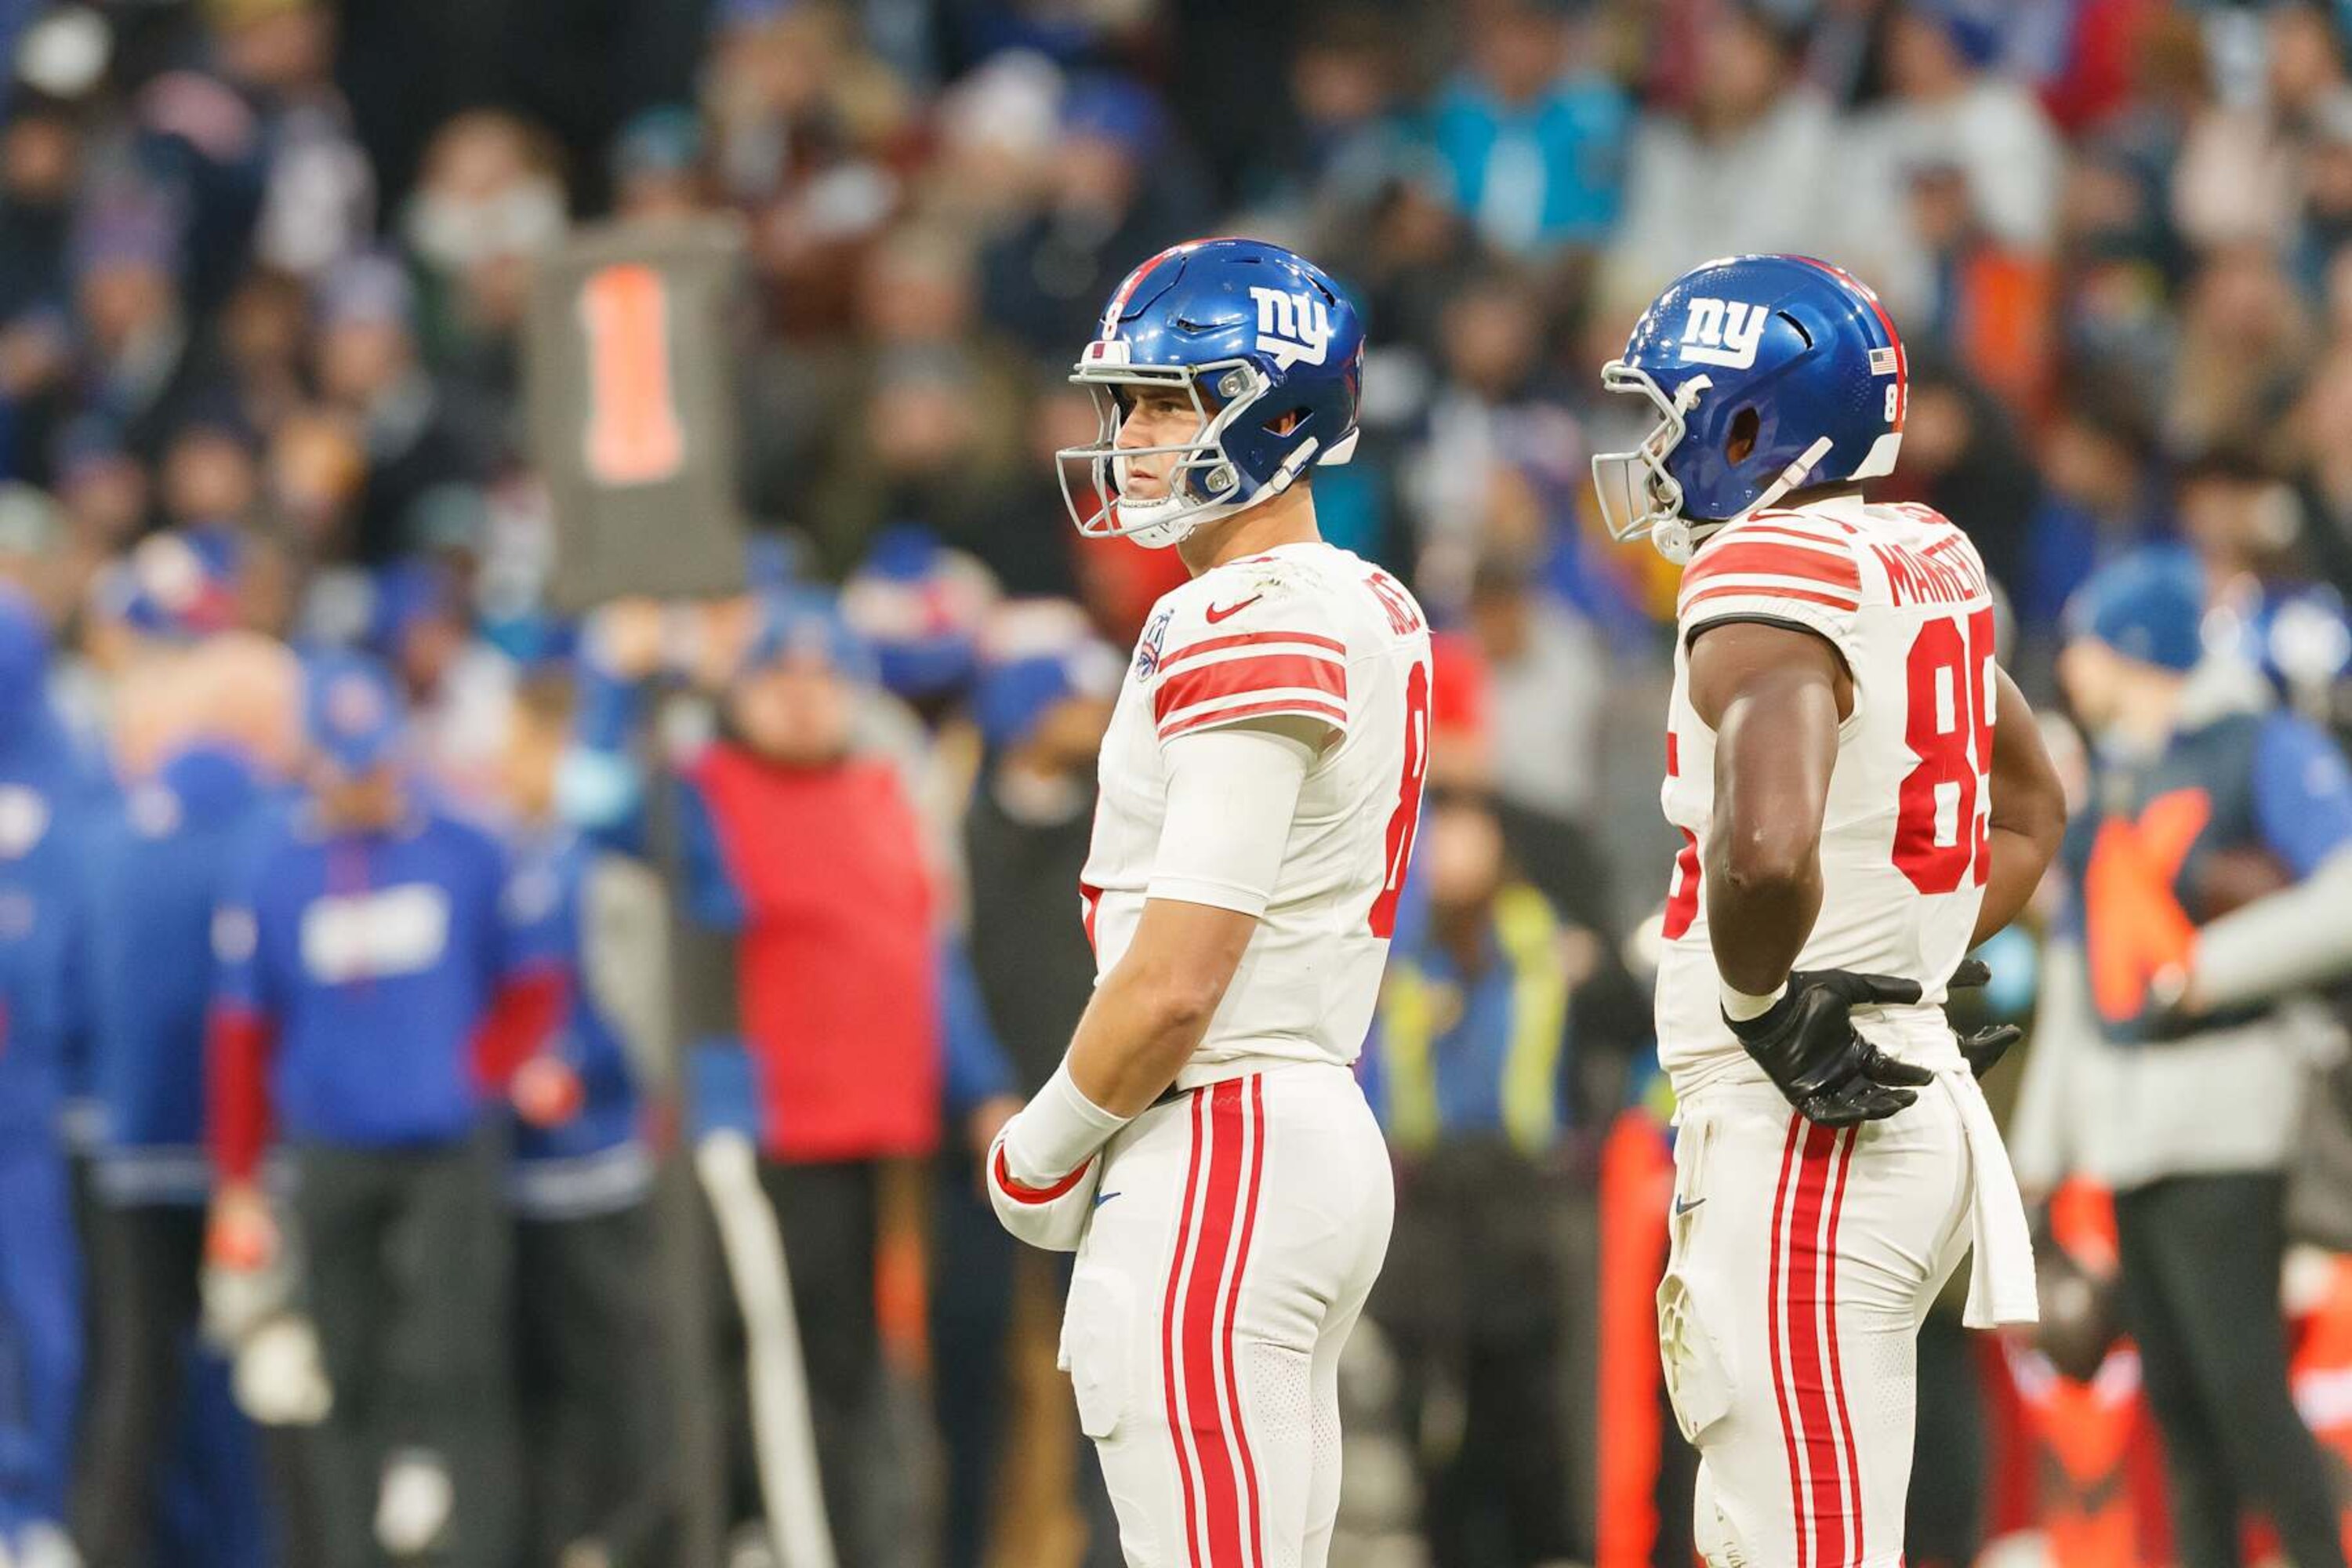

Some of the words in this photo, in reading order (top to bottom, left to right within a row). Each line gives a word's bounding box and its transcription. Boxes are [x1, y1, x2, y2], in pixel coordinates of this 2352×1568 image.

[577, 260, 684, 486] 1
[1102, 301, 1124, 341] 8
[1892, 606, 1996, 895] 85
